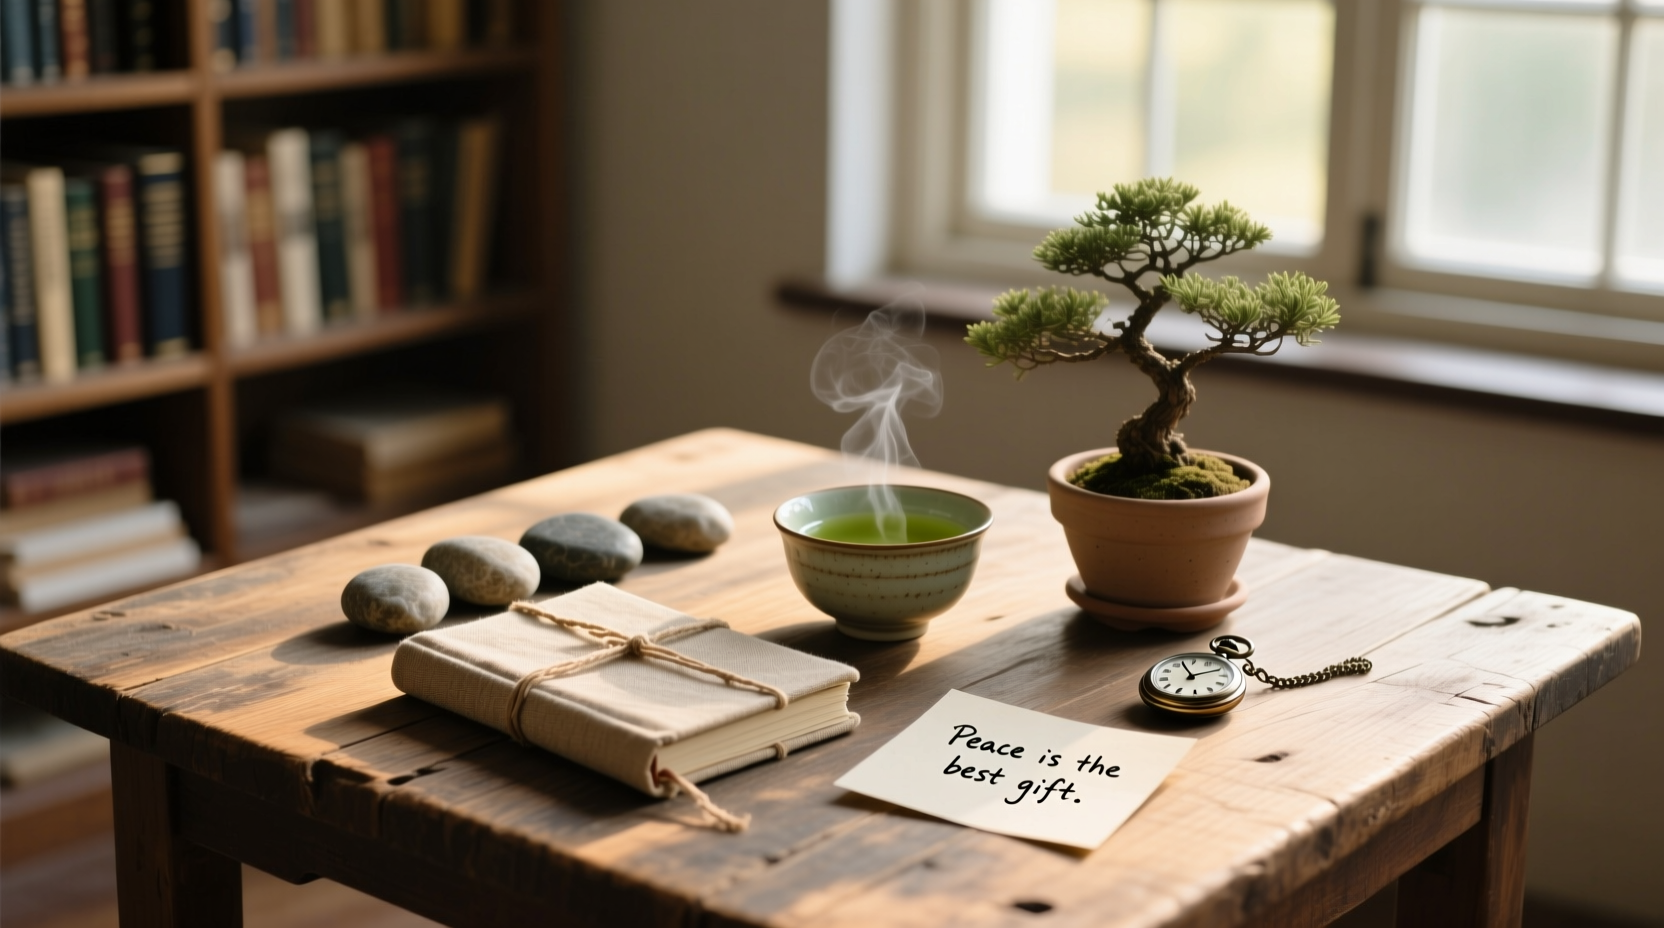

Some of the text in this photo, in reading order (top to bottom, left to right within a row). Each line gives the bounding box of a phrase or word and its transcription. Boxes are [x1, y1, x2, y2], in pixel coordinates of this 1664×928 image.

[948, 724, 1121, 778] Peace is the
[943, 755, 1081, 805] best gift.
